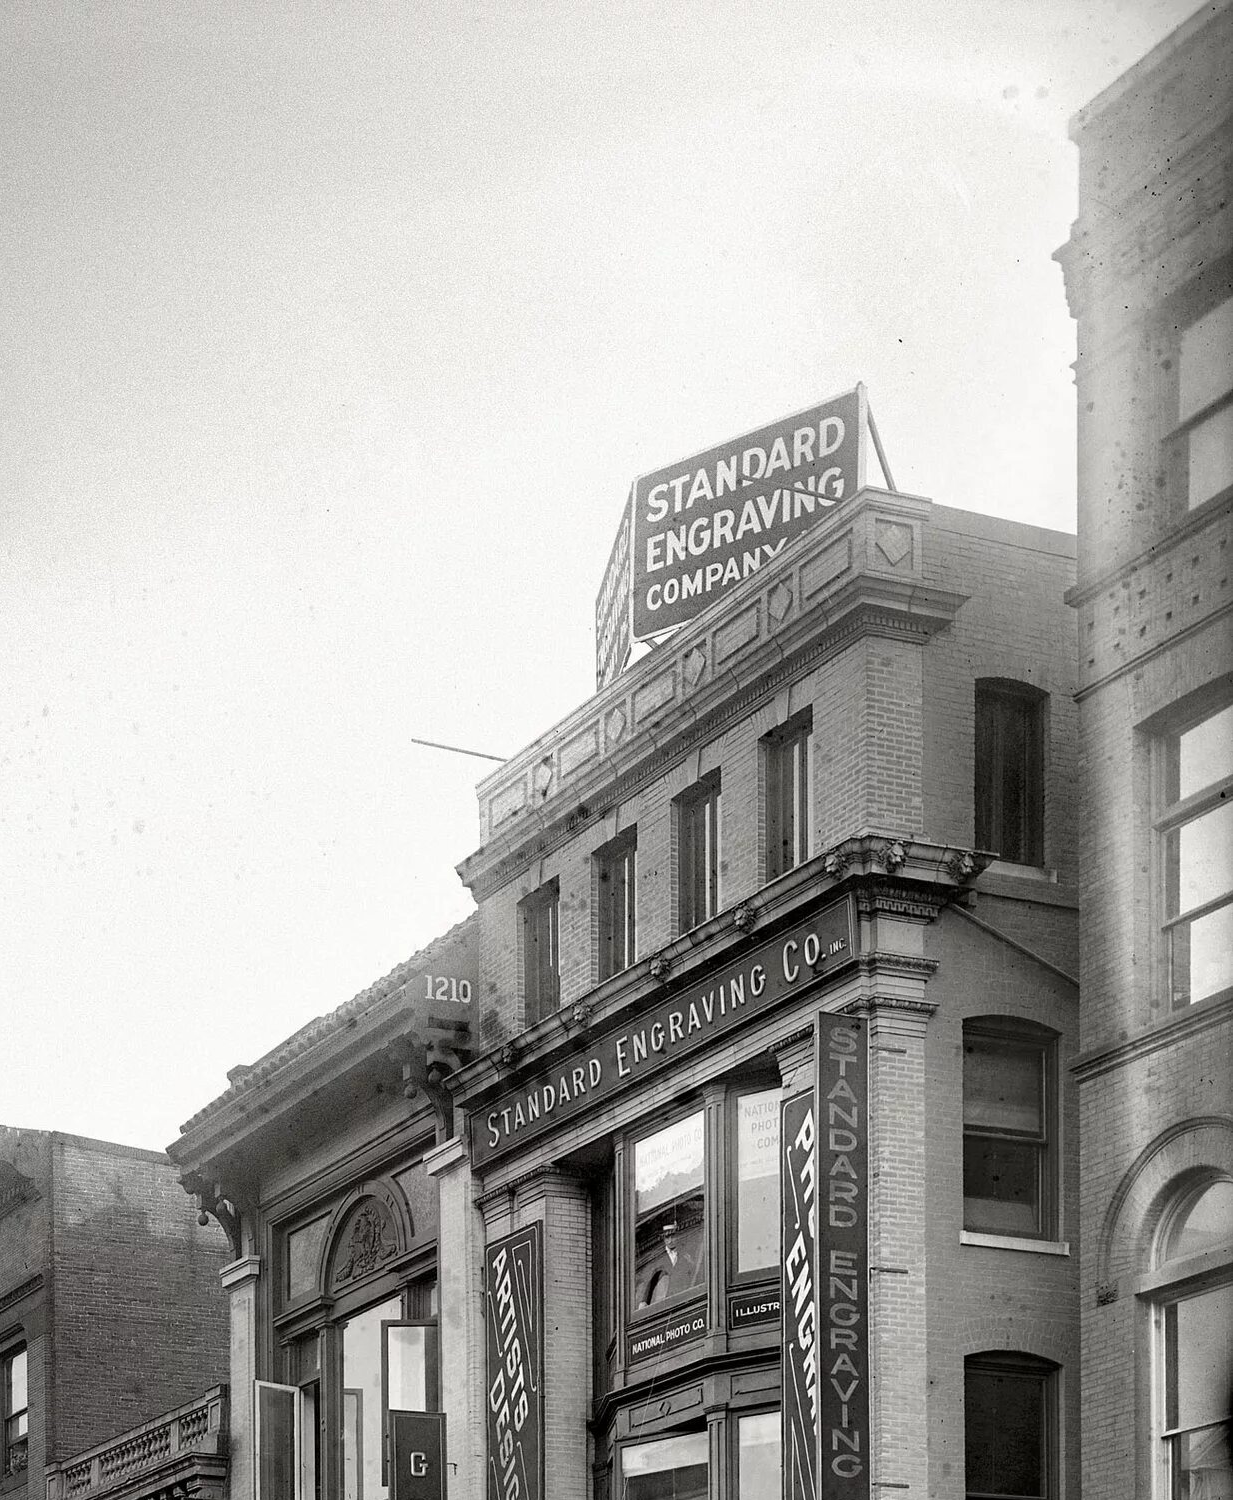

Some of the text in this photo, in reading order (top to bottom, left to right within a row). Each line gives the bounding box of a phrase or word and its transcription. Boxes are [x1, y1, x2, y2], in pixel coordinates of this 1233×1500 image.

[646, 416, 845, 523] STANDARD
[646, 466, 845, 573] ENGRAVING
[646, 537, 788, 611] COMPANY
[424, 975, 471, 1003] 1210
[487, 933, 848, 1149] STANDARD ENGRAVING CO. INC.
[827, 1027, 859, 1228] STANDARD
[492, 1247, 529, 1433] ARTISTS
[632, 1319, 705, 1355] NATIONAL PHOTO CO.
[829, 1250, 864, 1478] ENGRAVING
